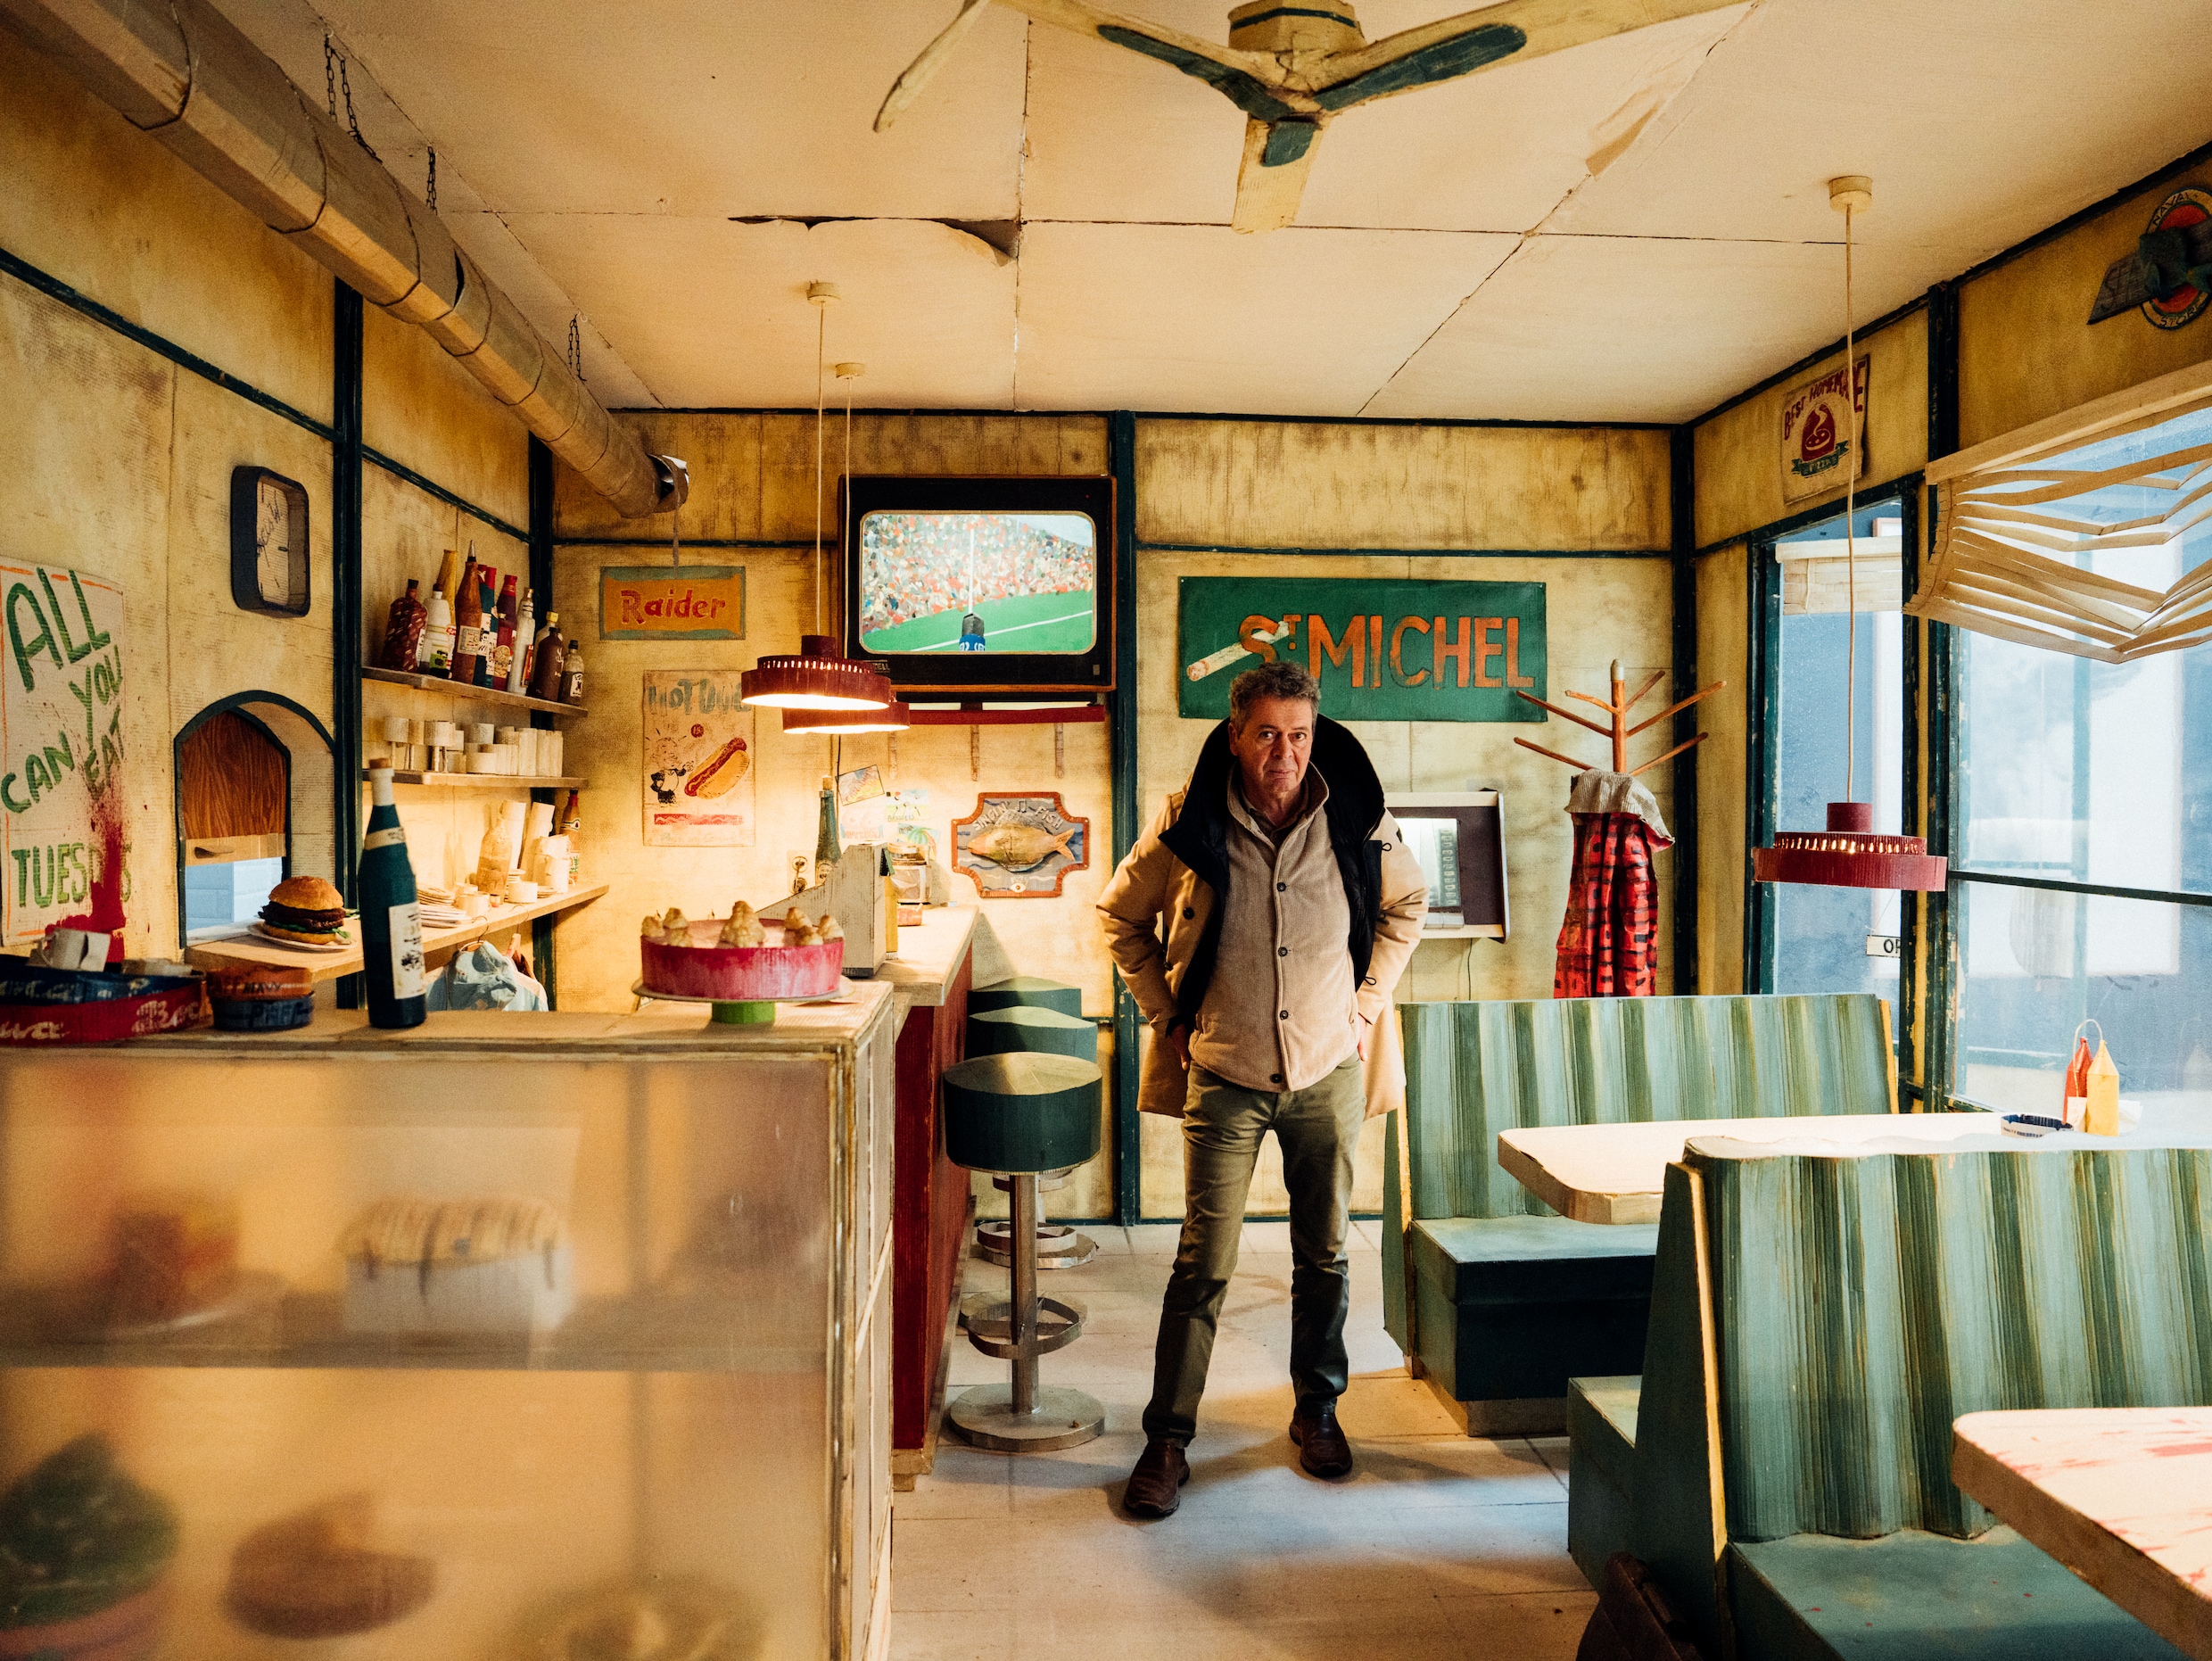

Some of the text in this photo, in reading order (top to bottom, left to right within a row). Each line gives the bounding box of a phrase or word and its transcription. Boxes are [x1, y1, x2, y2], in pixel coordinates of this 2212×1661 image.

[1784, 396, 1806, 441] BEST
[6, 566, 111, 693] ALL
[620, 589, 726, 624] Raider
[1308, 614, 1535, 690] MICHEL
[68, 644, 124, 751] YOU
[1, 704, 125, 814] CAN EAT
